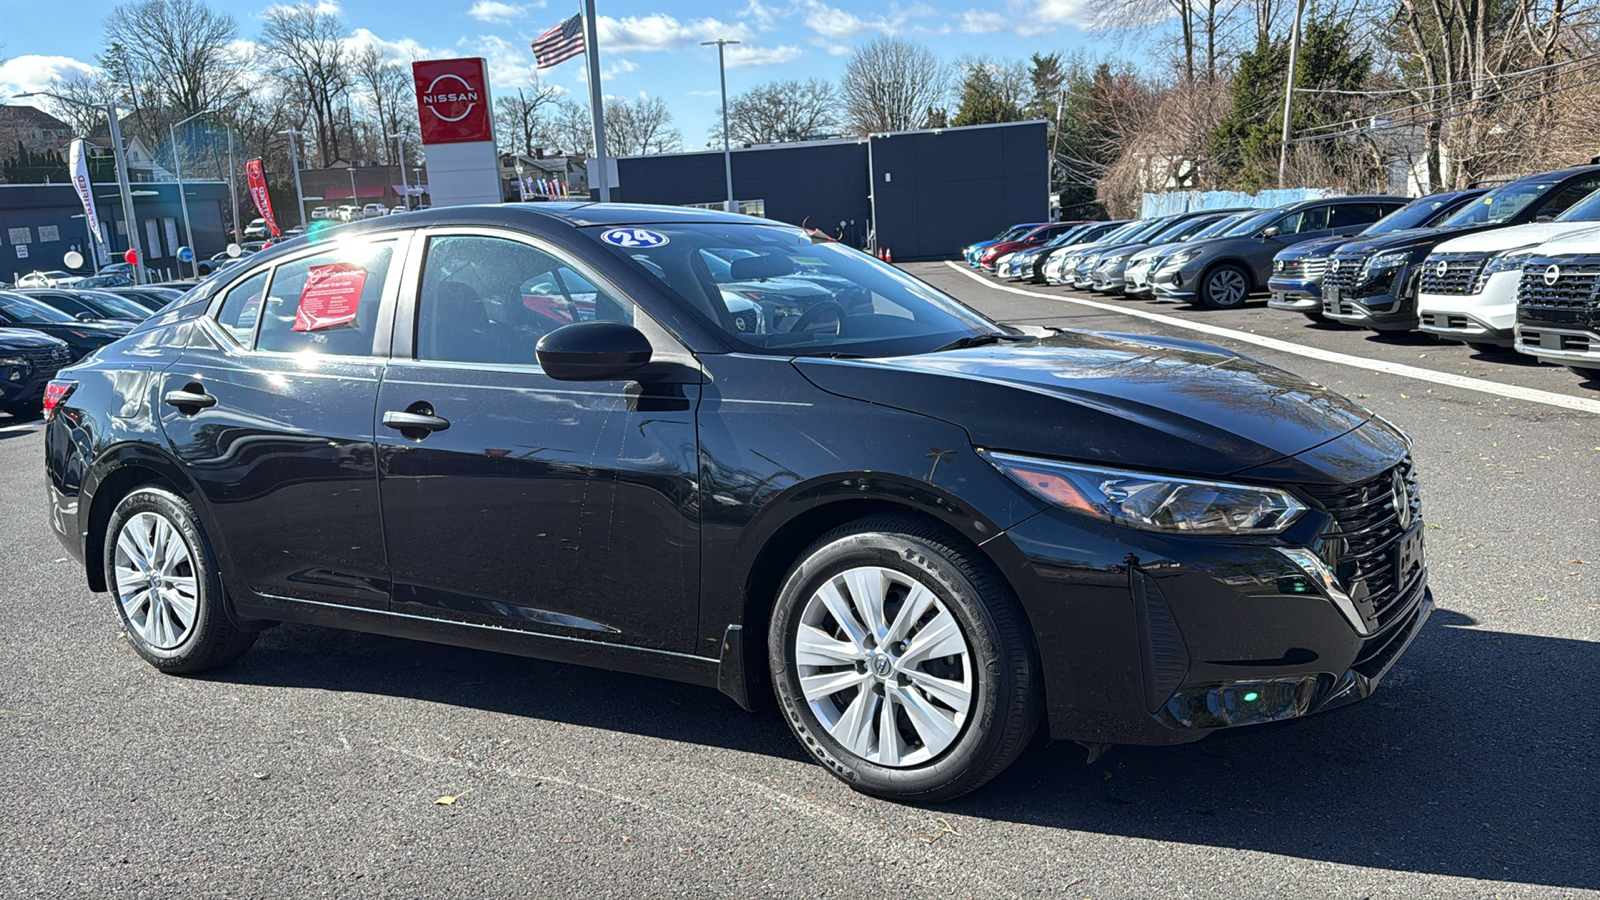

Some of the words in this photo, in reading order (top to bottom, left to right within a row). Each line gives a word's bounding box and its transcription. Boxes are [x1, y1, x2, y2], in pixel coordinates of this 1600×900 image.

[423, 92, 478, 104] NISSAN
[612, 229, 659, 247] 24
[904, 547, 994, 653] Firestone
[778, 681, 857, 783] Firestone
